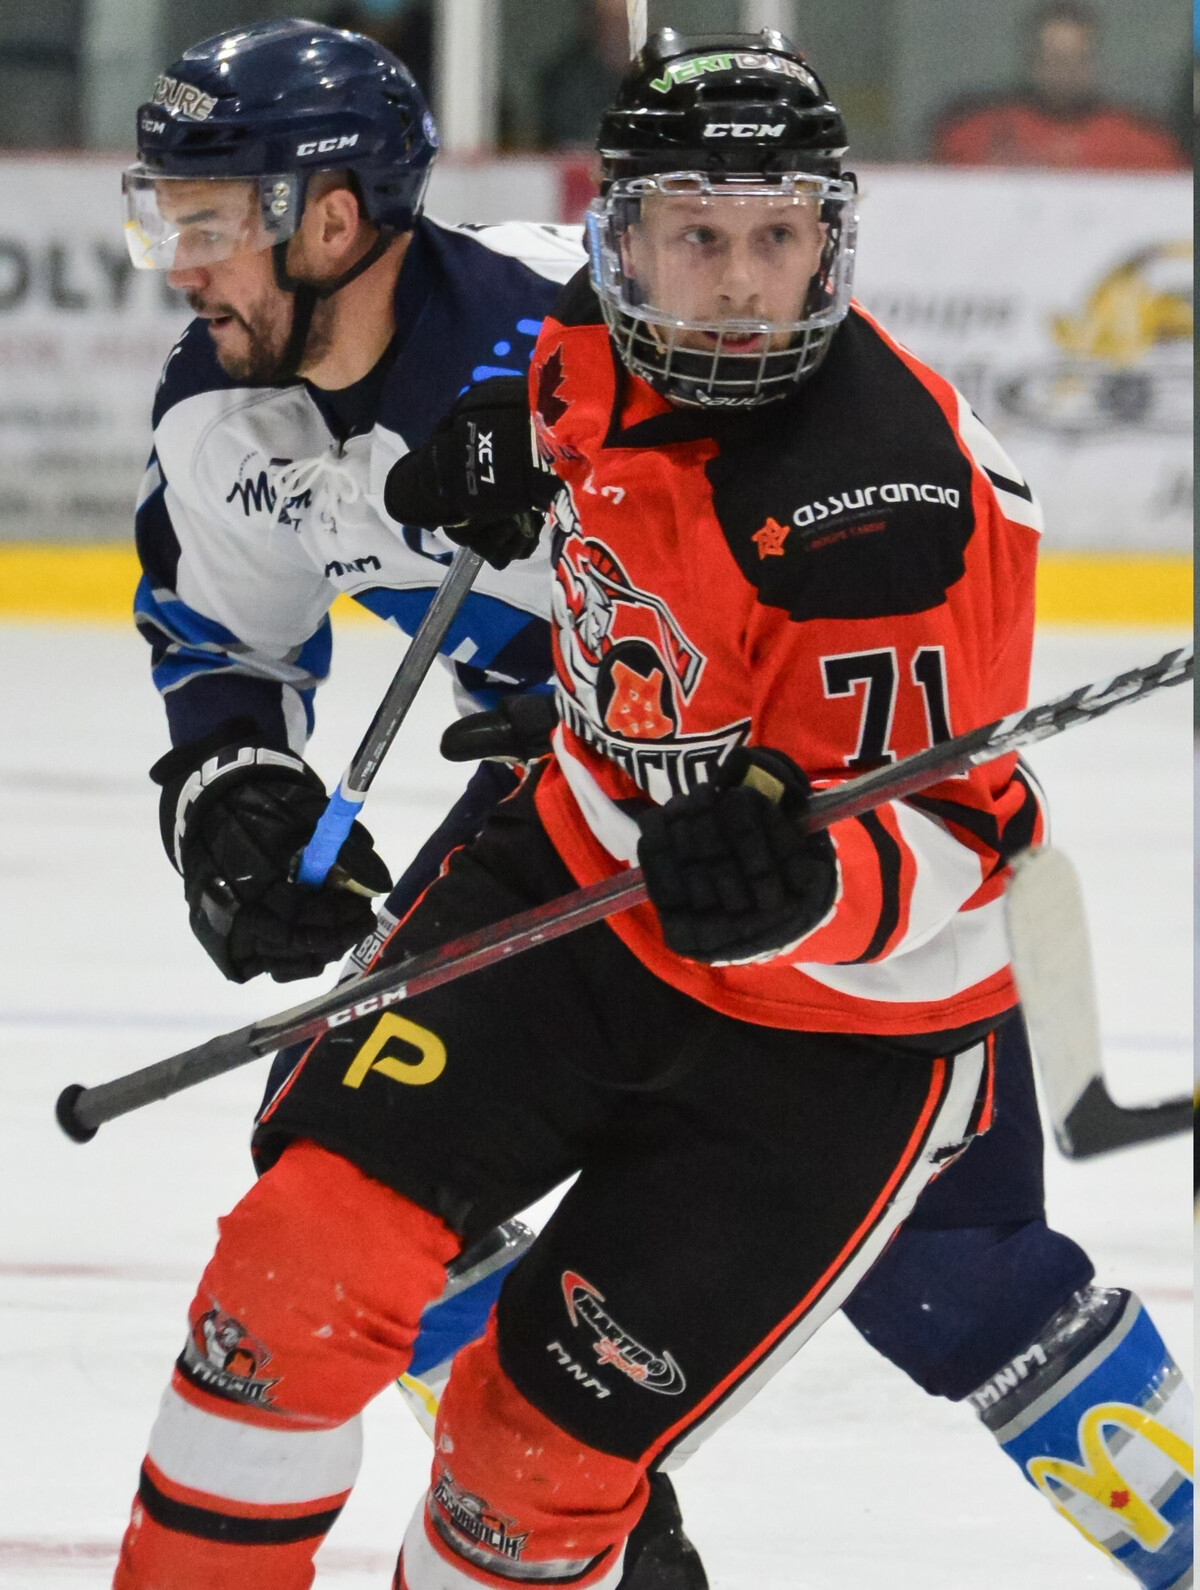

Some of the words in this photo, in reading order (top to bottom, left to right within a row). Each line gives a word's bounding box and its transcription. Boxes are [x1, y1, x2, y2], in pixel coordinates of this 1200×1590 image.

[296, 134, 360, 157] CCM
[703, 123, 787, 138] CCM
[478, 431, 496, 484] XC7
[793, 483, 960, 527] assurancia
[820, 646, 968, 779] 71
[326, 986, 407, 1029] CCM
[546, 1341, 611, 1399] MNM
[974, 1344, 1048, 1409] MNM
